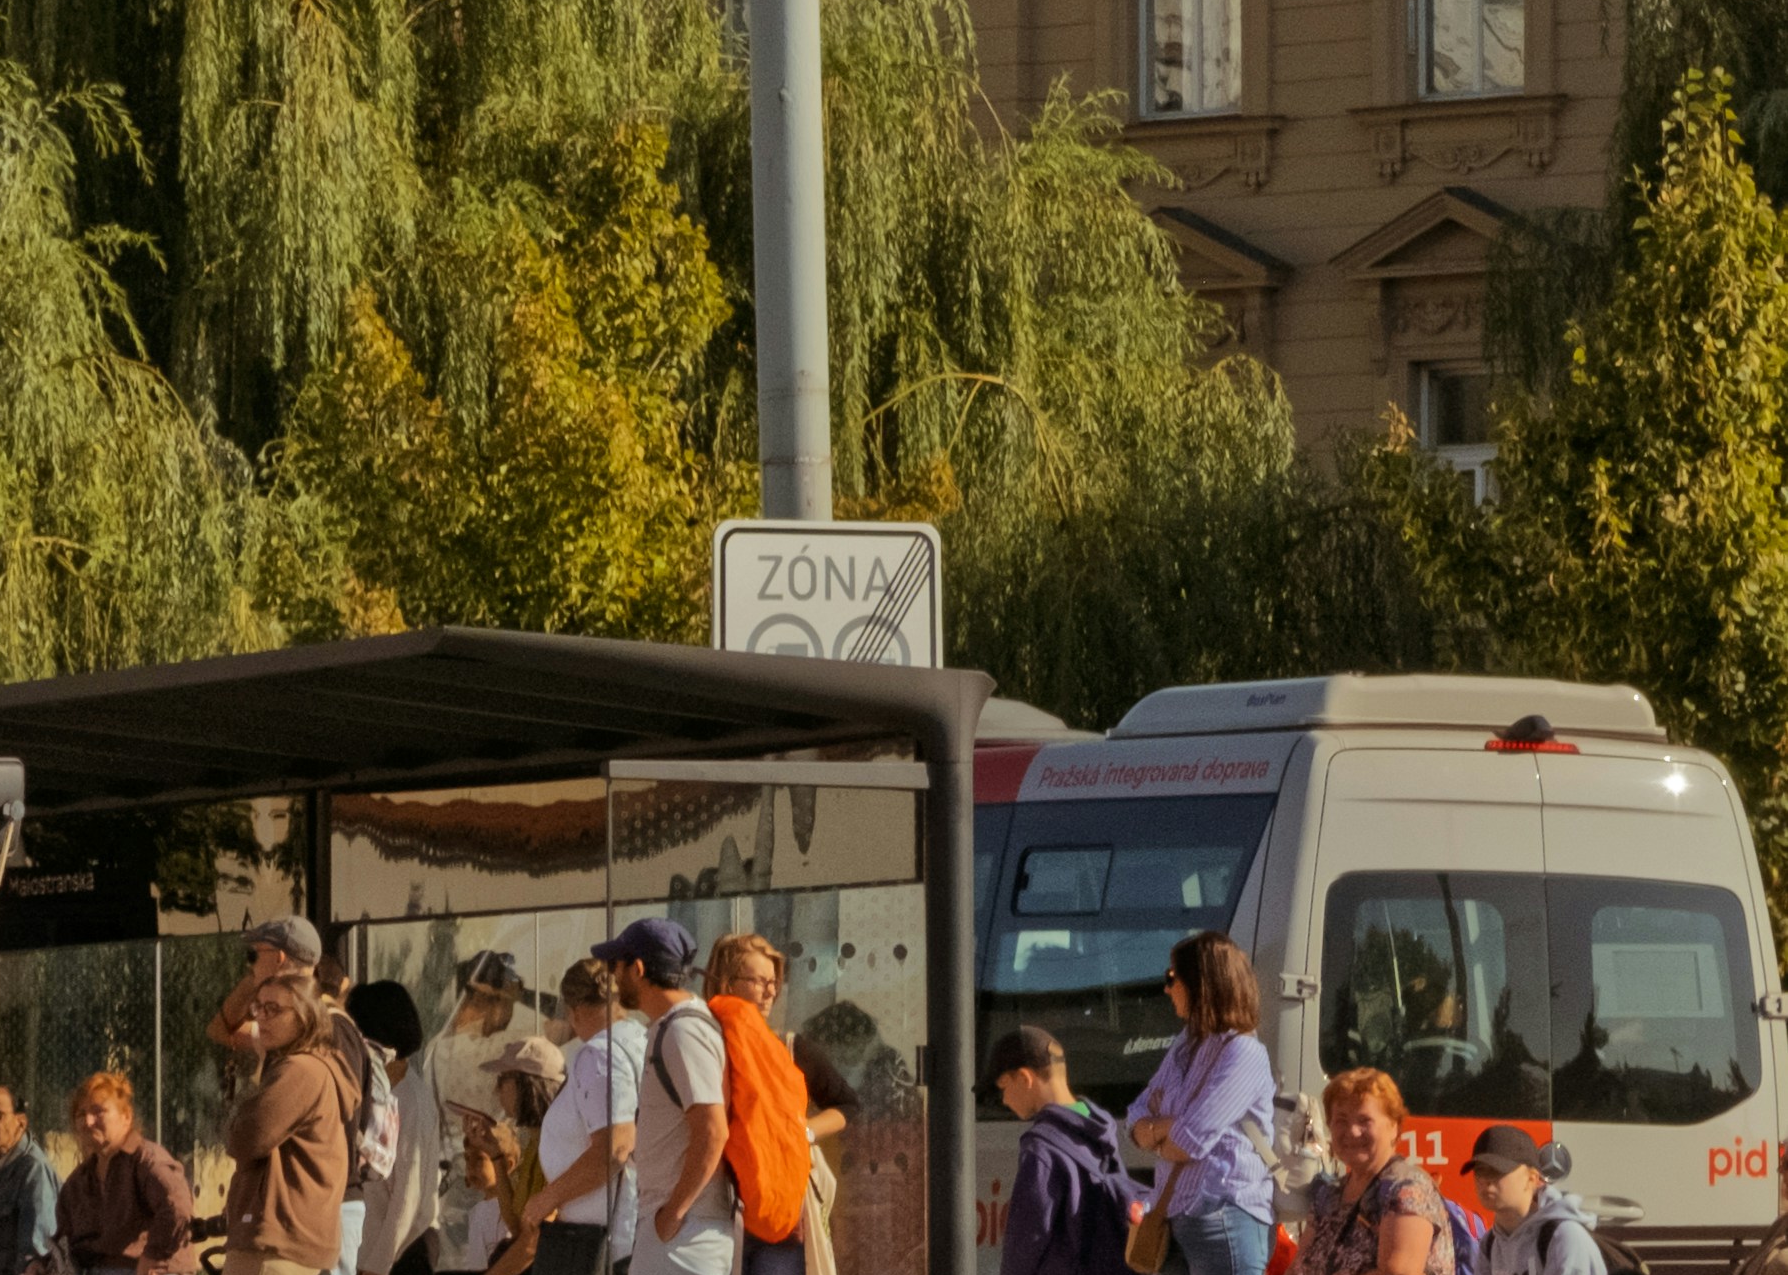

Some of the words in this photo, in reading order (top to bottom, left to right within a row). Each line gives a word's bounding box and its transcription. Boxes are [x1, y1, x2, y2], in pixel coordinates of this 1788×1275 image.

[757, 544, 896, 602] ZÓNA
[1037, 762, 1100, 789] Pražská
[1103, 757, 1201, 790] integrovaná
[1202, 757, 1270, 786] doprava
[1709, 1136, 1768, 1187] pid
